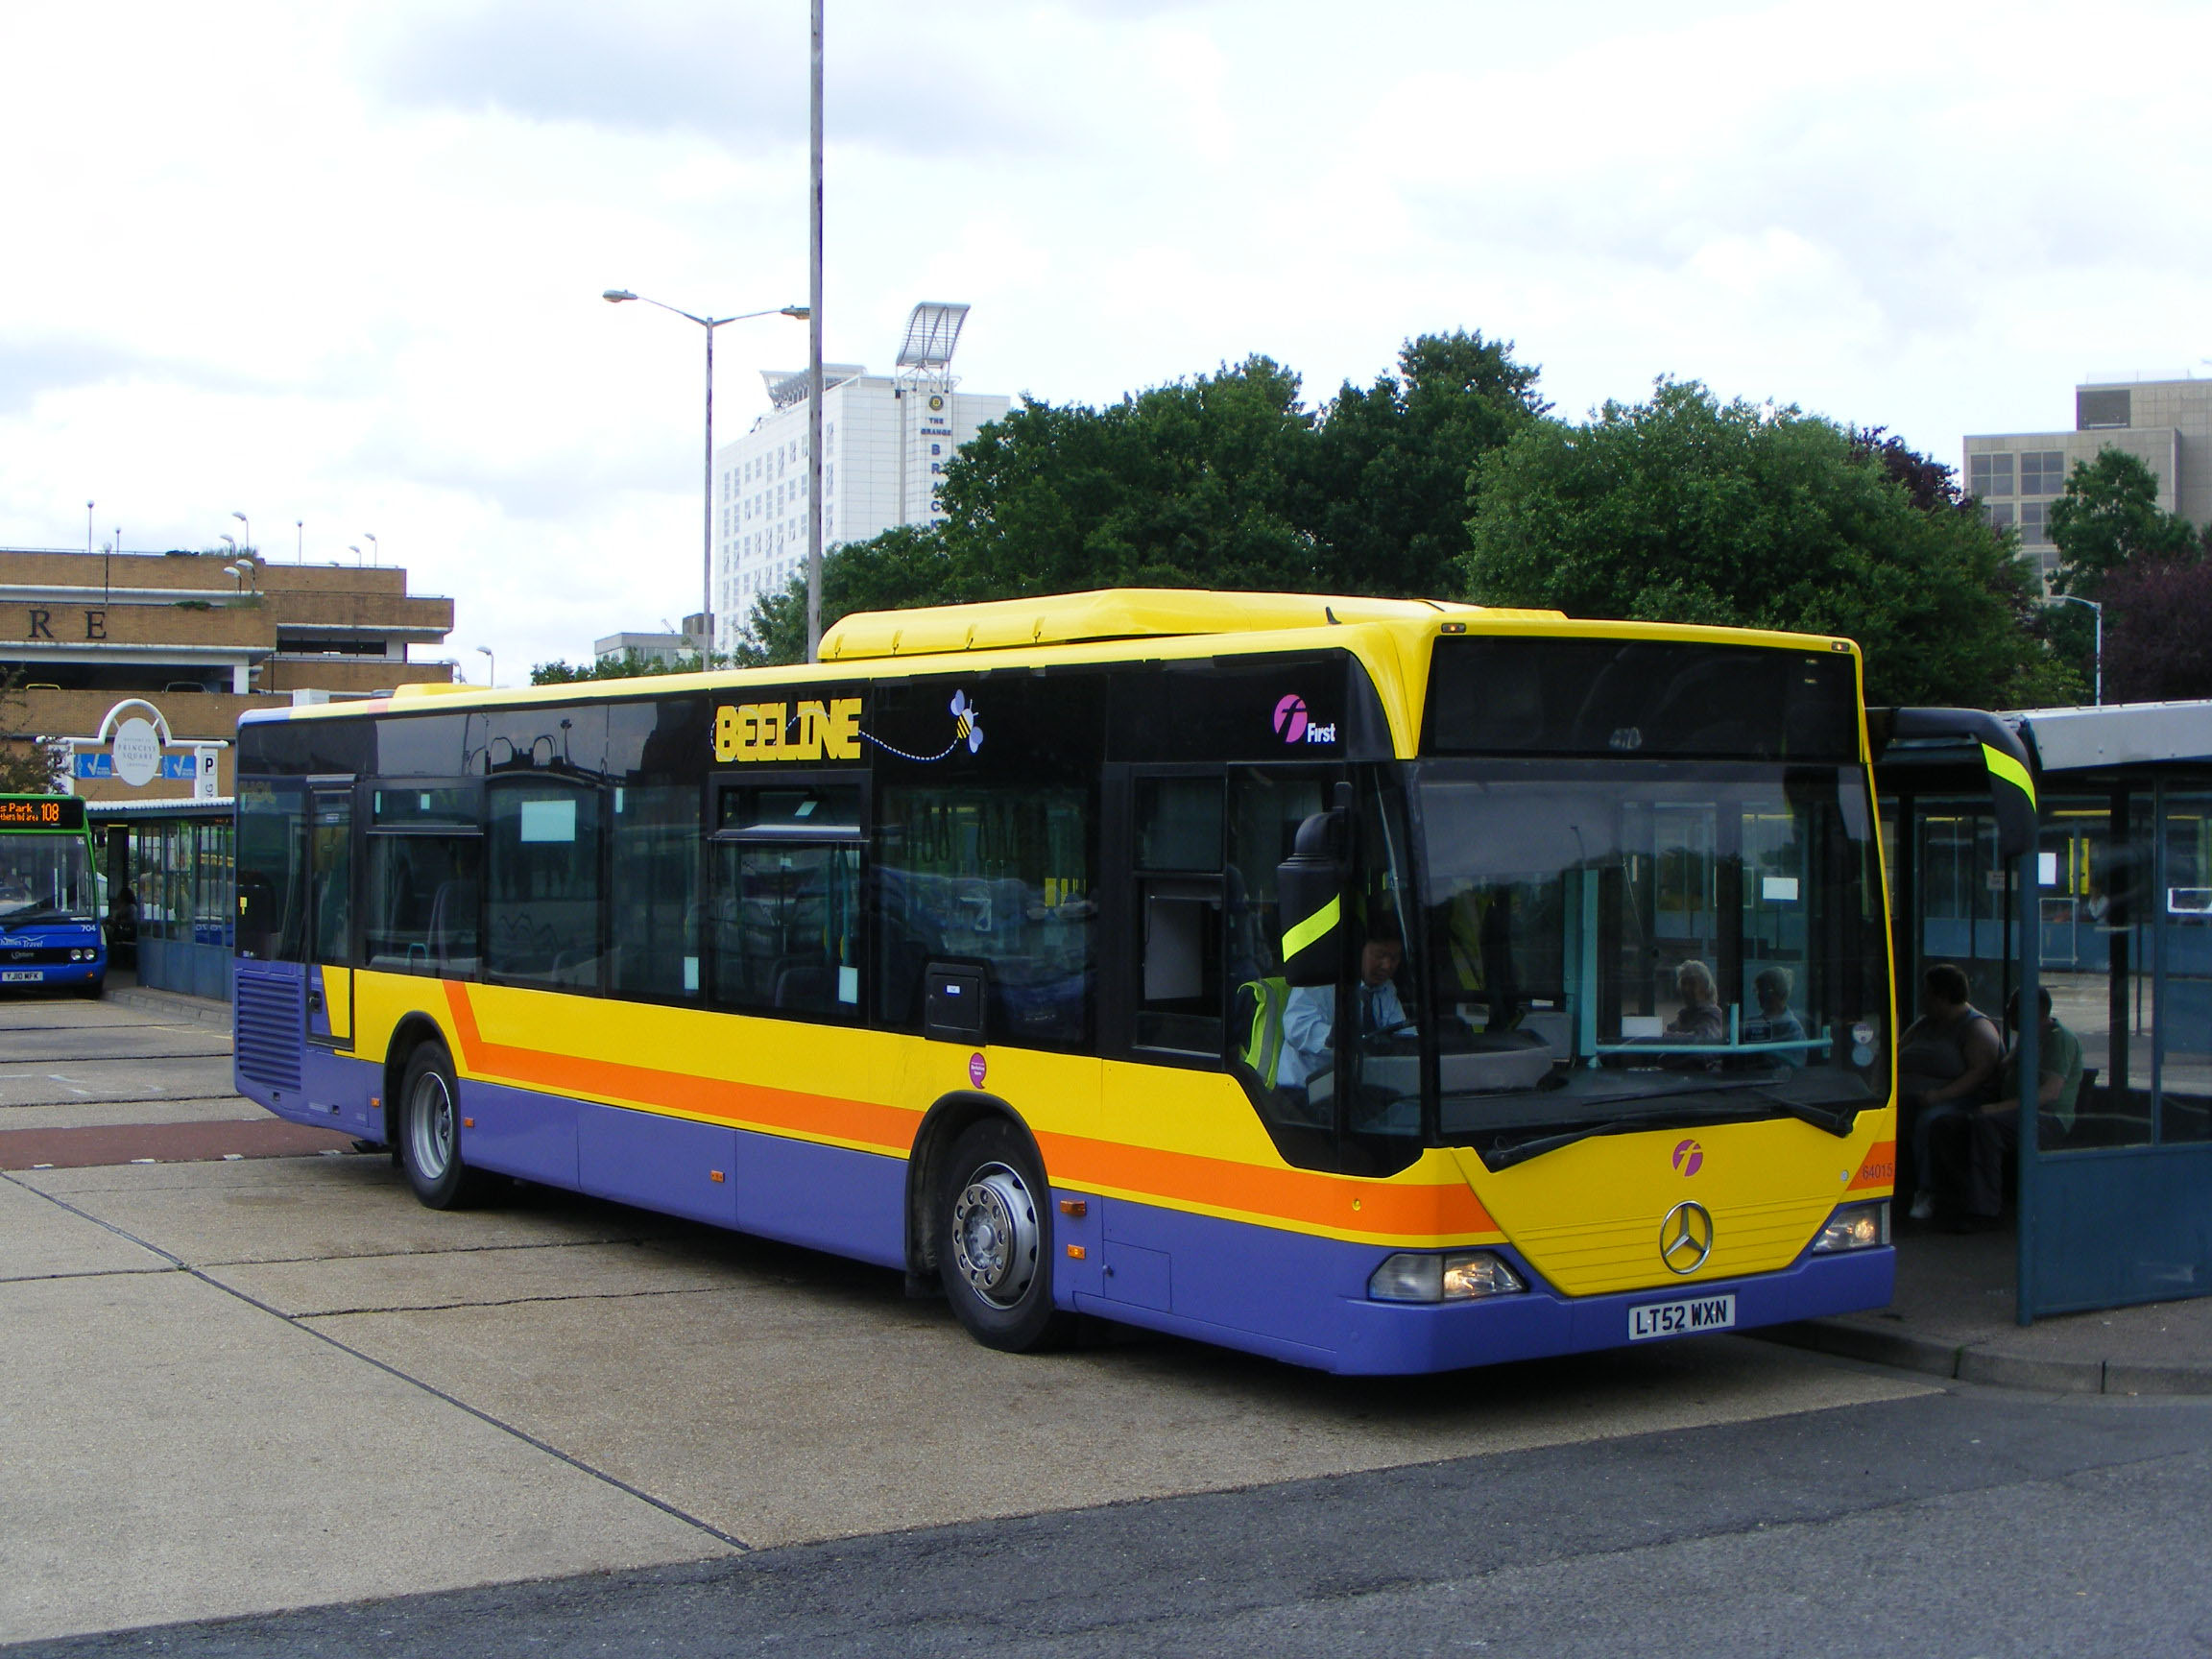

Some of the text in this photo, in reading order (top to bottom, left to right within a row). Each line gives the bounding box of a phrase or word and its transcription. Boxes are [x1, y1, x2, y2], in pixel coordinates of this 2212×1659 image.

[715, 698, 862, 761] BEELINE
[1307, 722, 1335, 742] First
[205, 757, 213, 773] P
[9, 803, 33, 812] Park
[41, 803, 60, 822] 108
[1863, 1163, 1893, 1180] 64015
[1636, 1299, 1726, 1334] LT52 WXN
